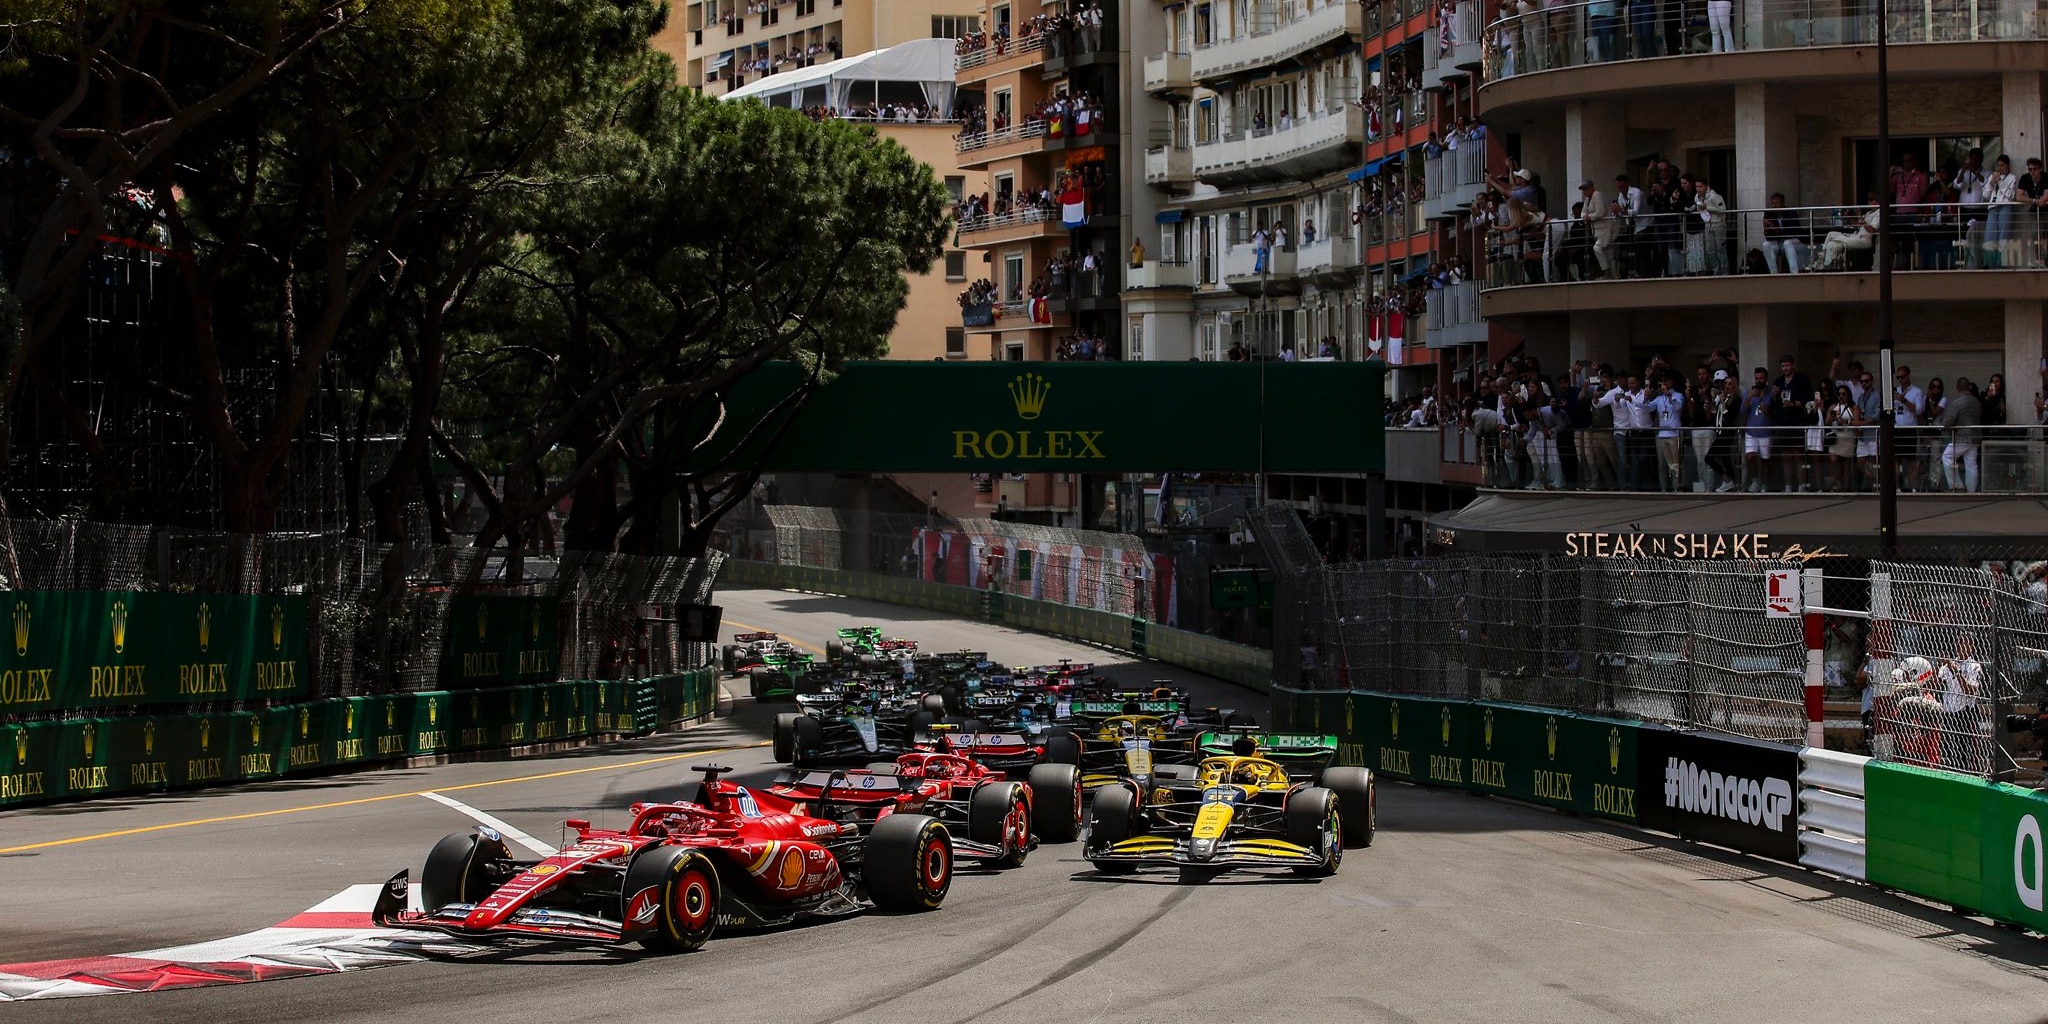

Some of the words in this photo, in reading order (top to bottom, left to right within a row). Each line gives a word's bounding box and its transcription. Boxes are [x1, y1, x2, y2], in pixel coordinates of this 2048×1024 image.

[952, 430, 1106, 459] ROLEX
[1565, 532, 1645, 558] STEAK
[1653, 537, 1665, 555] N
[1674, 533, 1769, 559] SHAKE
[463, 652, 500, 678] ROLEX
[518, 650, 550, 674] ROLEX
[90, 665, 146, 698] ROLEX
[179, 663, 227, 694] ROLEX
[256, 660, 296, 690] ROLEX
[1, 771, 43, 798] ROLEX
[69, 766, 108, 790] ROLEX
[131, 761, 168, 785] ROLEX
[188, 757, 221, 781] ROLEX
[240, 753, 271, 774] ROLEX
[290, 743, 319, 766] ROLEX
[337, 738, 363, 759] ROLEX
[378, 735, 403, 753] ROLEX
[419, 730, 446, 748] ROLEX
[462, 727, 488, 746] ROLEX
[1338, 743, 1365, 766] ROLEX
[1381, 747, 1411, 775] ROLEX
[1430, 755, 1462, 783] ROLEX
[1472, 761, 1505, 788] ROLEX
[1534, 769, 1572, 800] ROLEX
[1594, 783, 1635, 818] ROLEX
[810, 823, 837, 837] Santander
[730, 916, 746, 925] PLAY
